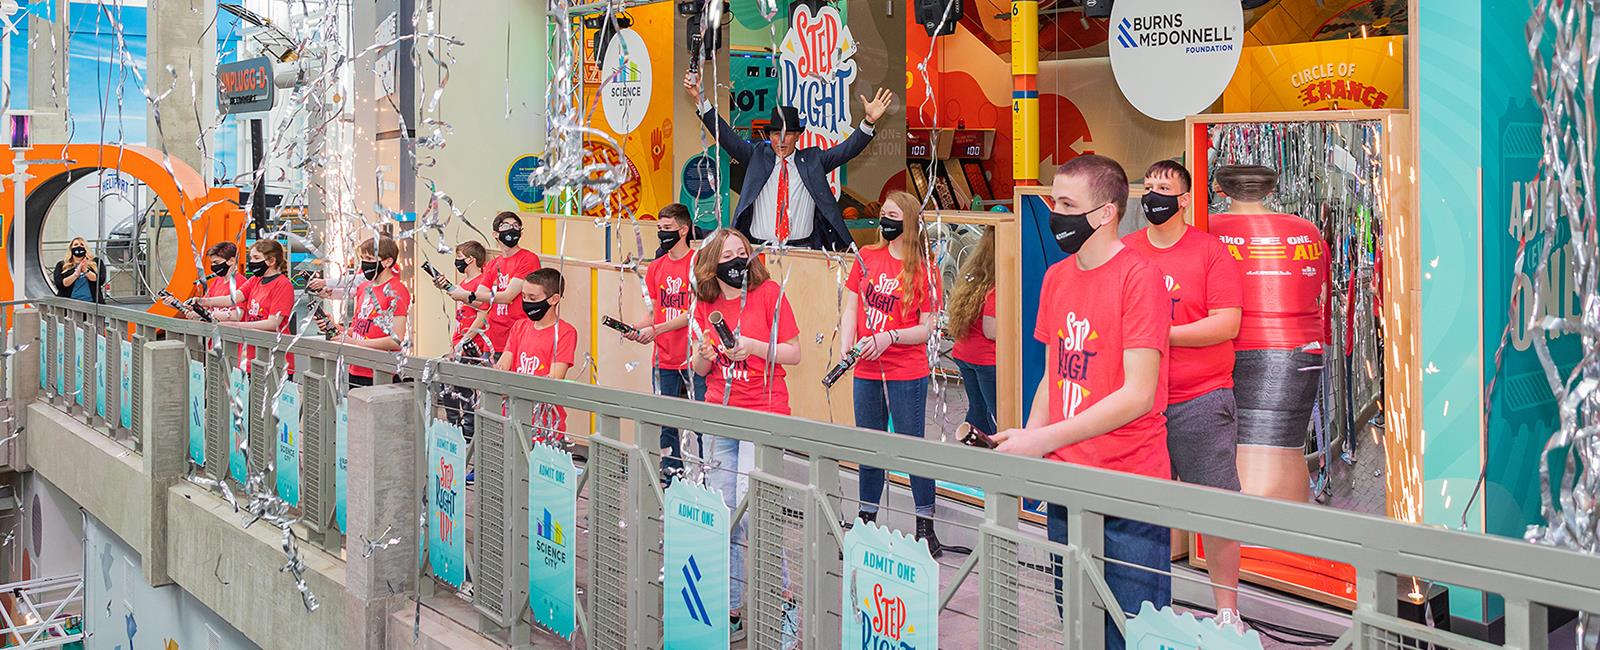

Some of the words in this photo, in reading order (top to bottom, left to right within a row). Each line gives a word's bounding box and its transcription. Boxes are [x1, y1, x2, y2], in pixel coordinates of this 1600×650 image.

[1012, 3, 1018, 16] 6
[1133, 13, 1183, 31] BURNS
[797, 11, 838, 78] STEP
[1185, 44, 1233, 54] FOUNDATION
[1291, 63, 1334, 88] CIRCLE
[1337, 63, 1356, 77] OF
[611, 86, 641, 97] SCIENCE
[619, 98, 633, 106] CITY
[1302, 79, 1389, 109] CHANCE
[1013, 101, 1020, 113] 4
[911, 145, 926, 156] 100
[966, 146, 980, 156] 100
[874, 273, 899, 295] STEP
[866, 282, 900, 314] RIGHT
[517, 351, 540, 375] STEP
[440, 456, 454, 490] STEP
[539, 463, 554, 480] ADMIT
[555, 469, 565, 484] ONE
[435, 474, 457, 518] RIGHT
[679, 503, 700, 522] ADMIT
[702, 510, 714, 527] ONE
[439, 511, 453, 546] UP!
[536, 540, 566, 564] SCIENCE
[544, 556, 558, 570] CITY
[863, 551, 894, 575] ADMIT
[897, 562, 916, 583] ONE
[872, 583, 907, 641] STEP
